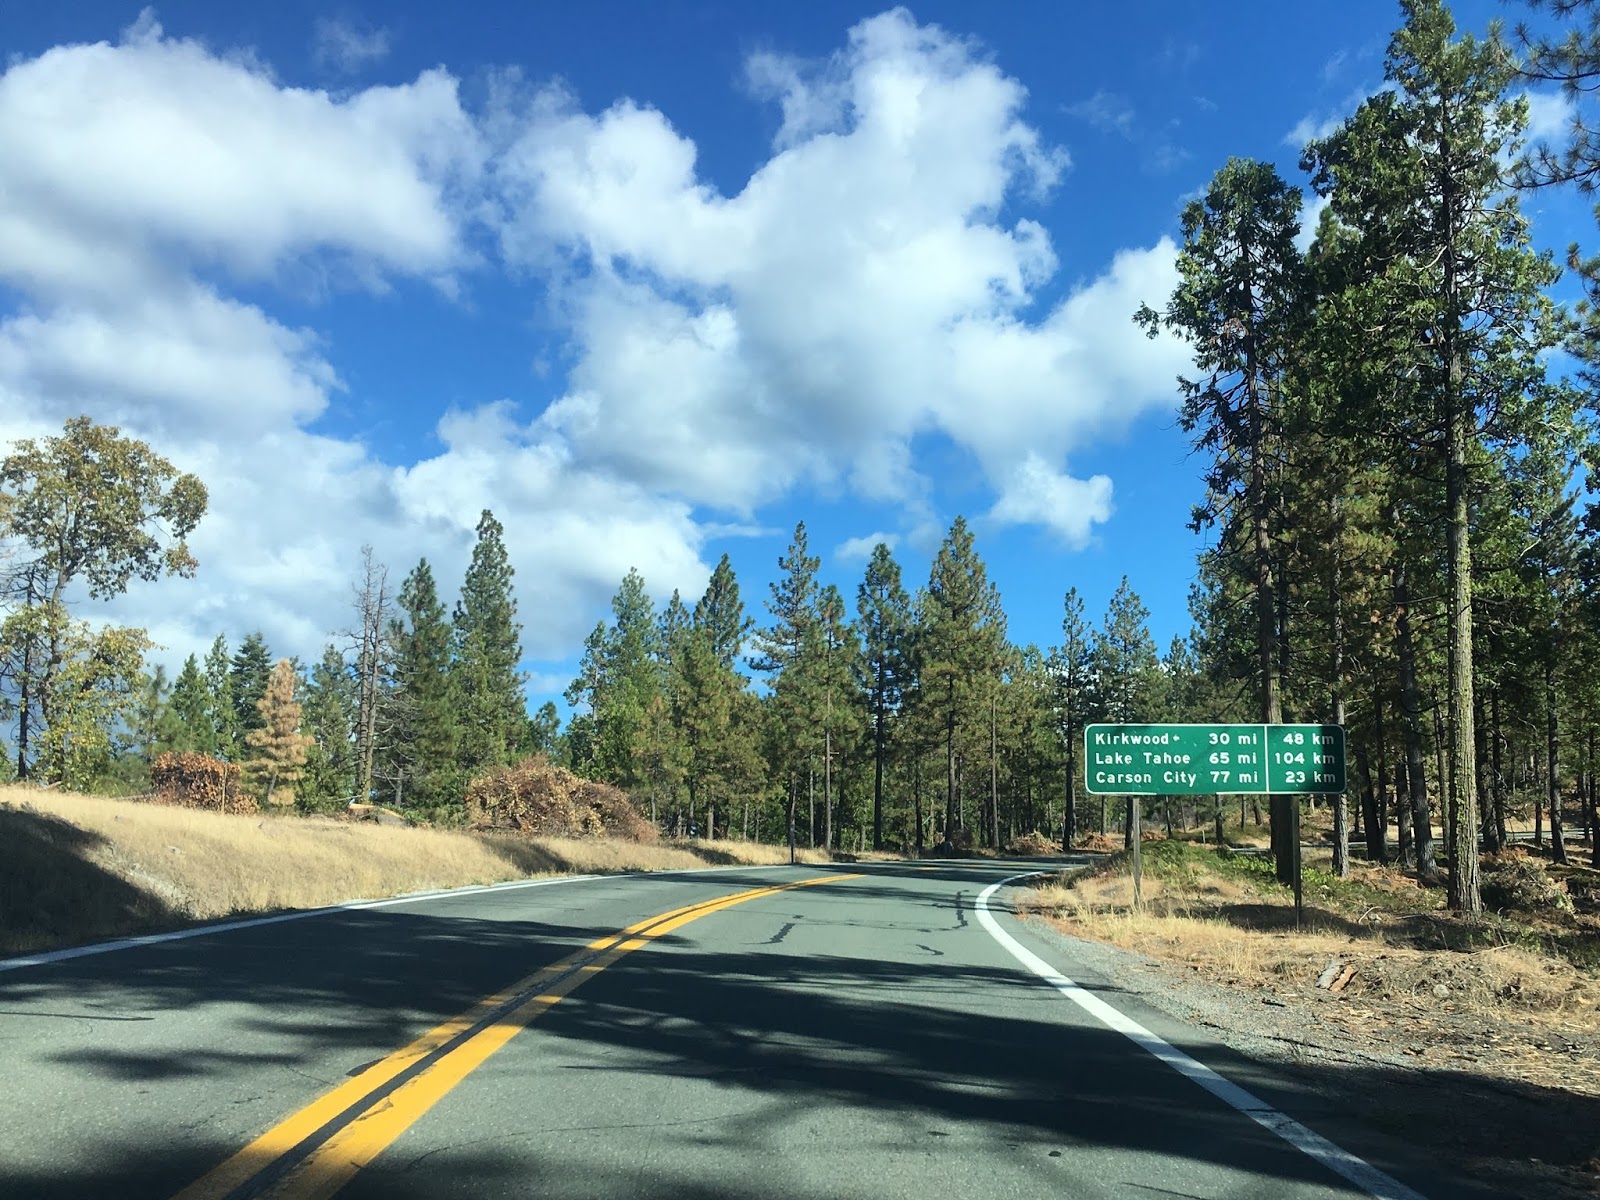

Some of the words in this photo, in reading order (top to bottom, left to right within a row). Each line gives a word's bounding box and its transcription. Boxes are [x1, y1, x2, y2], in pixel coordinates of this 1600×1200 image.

[1095, 733, 1169, 745] Kirkwood
[1209, 733, 1230, 745] 30
[1238, 733, 1257, 745] mi
[1283, 733, 1304, 745] 48
[1312, 733, 1334, 745] km
[1095, 752, 1133, 764] Lake
[1143, 752, 1191, 764] Tahoe
[1209, 752, 1230, 764] 65
[1238, 752, 1257, 764] mi
[1275, 752, 1305, 764] 104
[1313, 752, 1335, 764] km
[1096, 771, 1152, 783] Carson
[1163, 771, 1197, 787] City
[1210, 771, 1230, 783] 77
[1239, 771, 1258, 783] mi
[1285, 771, 1306, 783] 23
[1314, 771, 1336, 783] km
